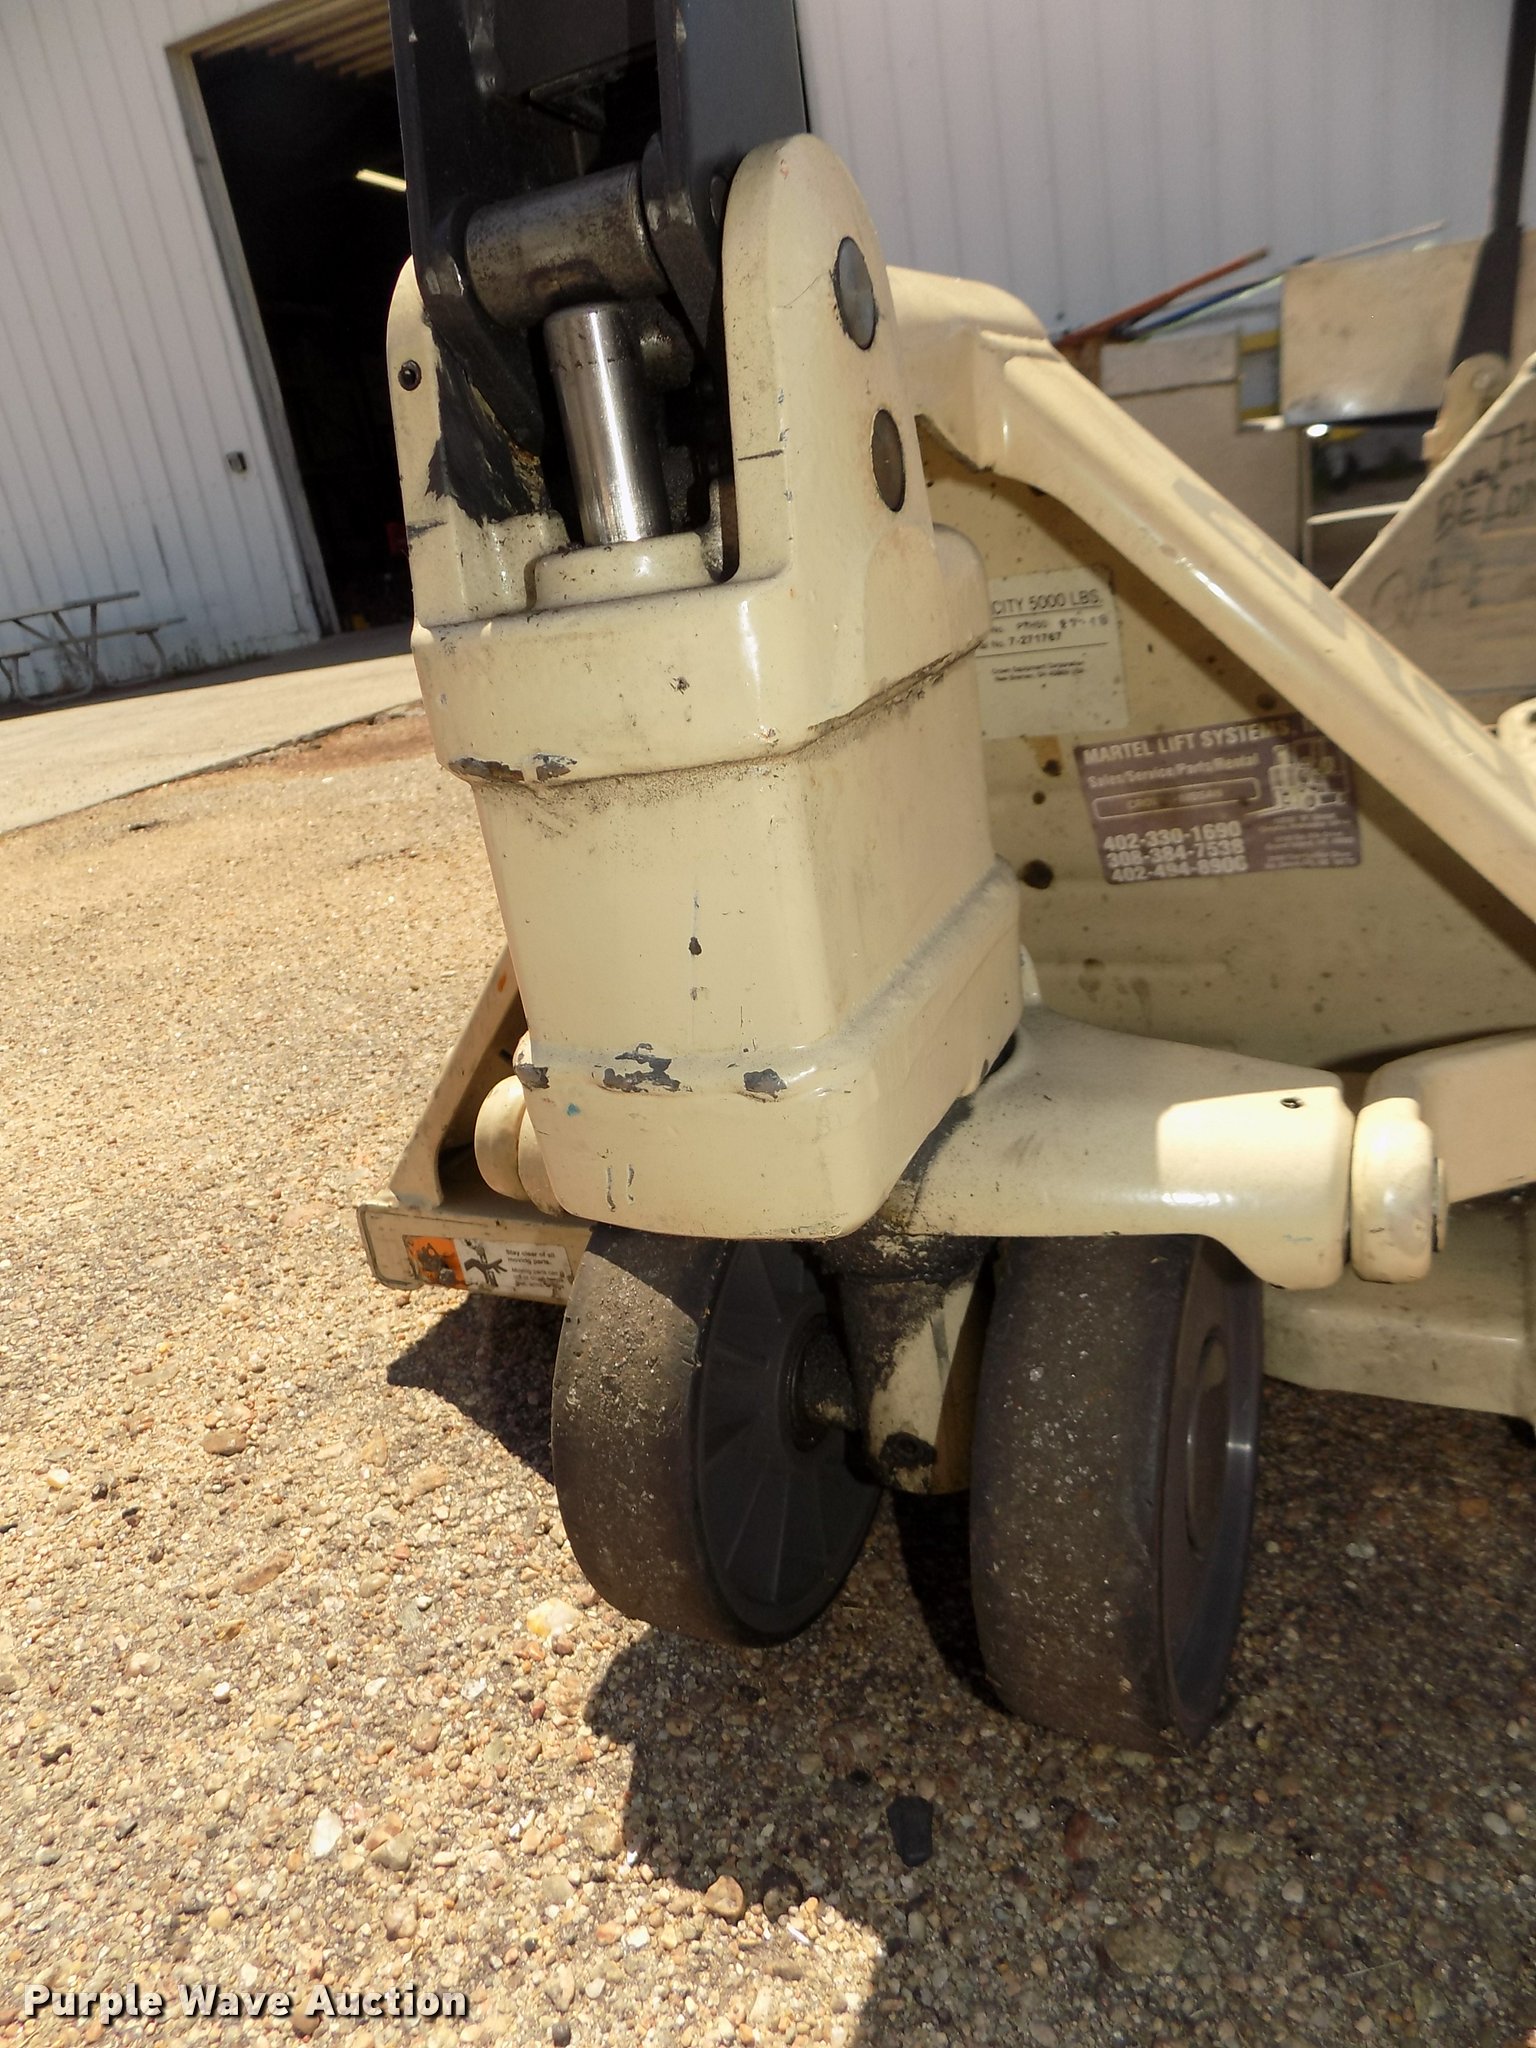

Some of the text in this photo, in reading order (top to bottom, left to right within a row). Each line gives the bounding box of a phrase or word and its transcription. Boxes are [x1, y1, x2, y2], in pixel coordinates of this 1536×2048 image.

[1028, 592, 1066, 611] 5000
[1083, 740, 1154, 765] MARTEL
[1156, 732, 1195, 753] LIFT
